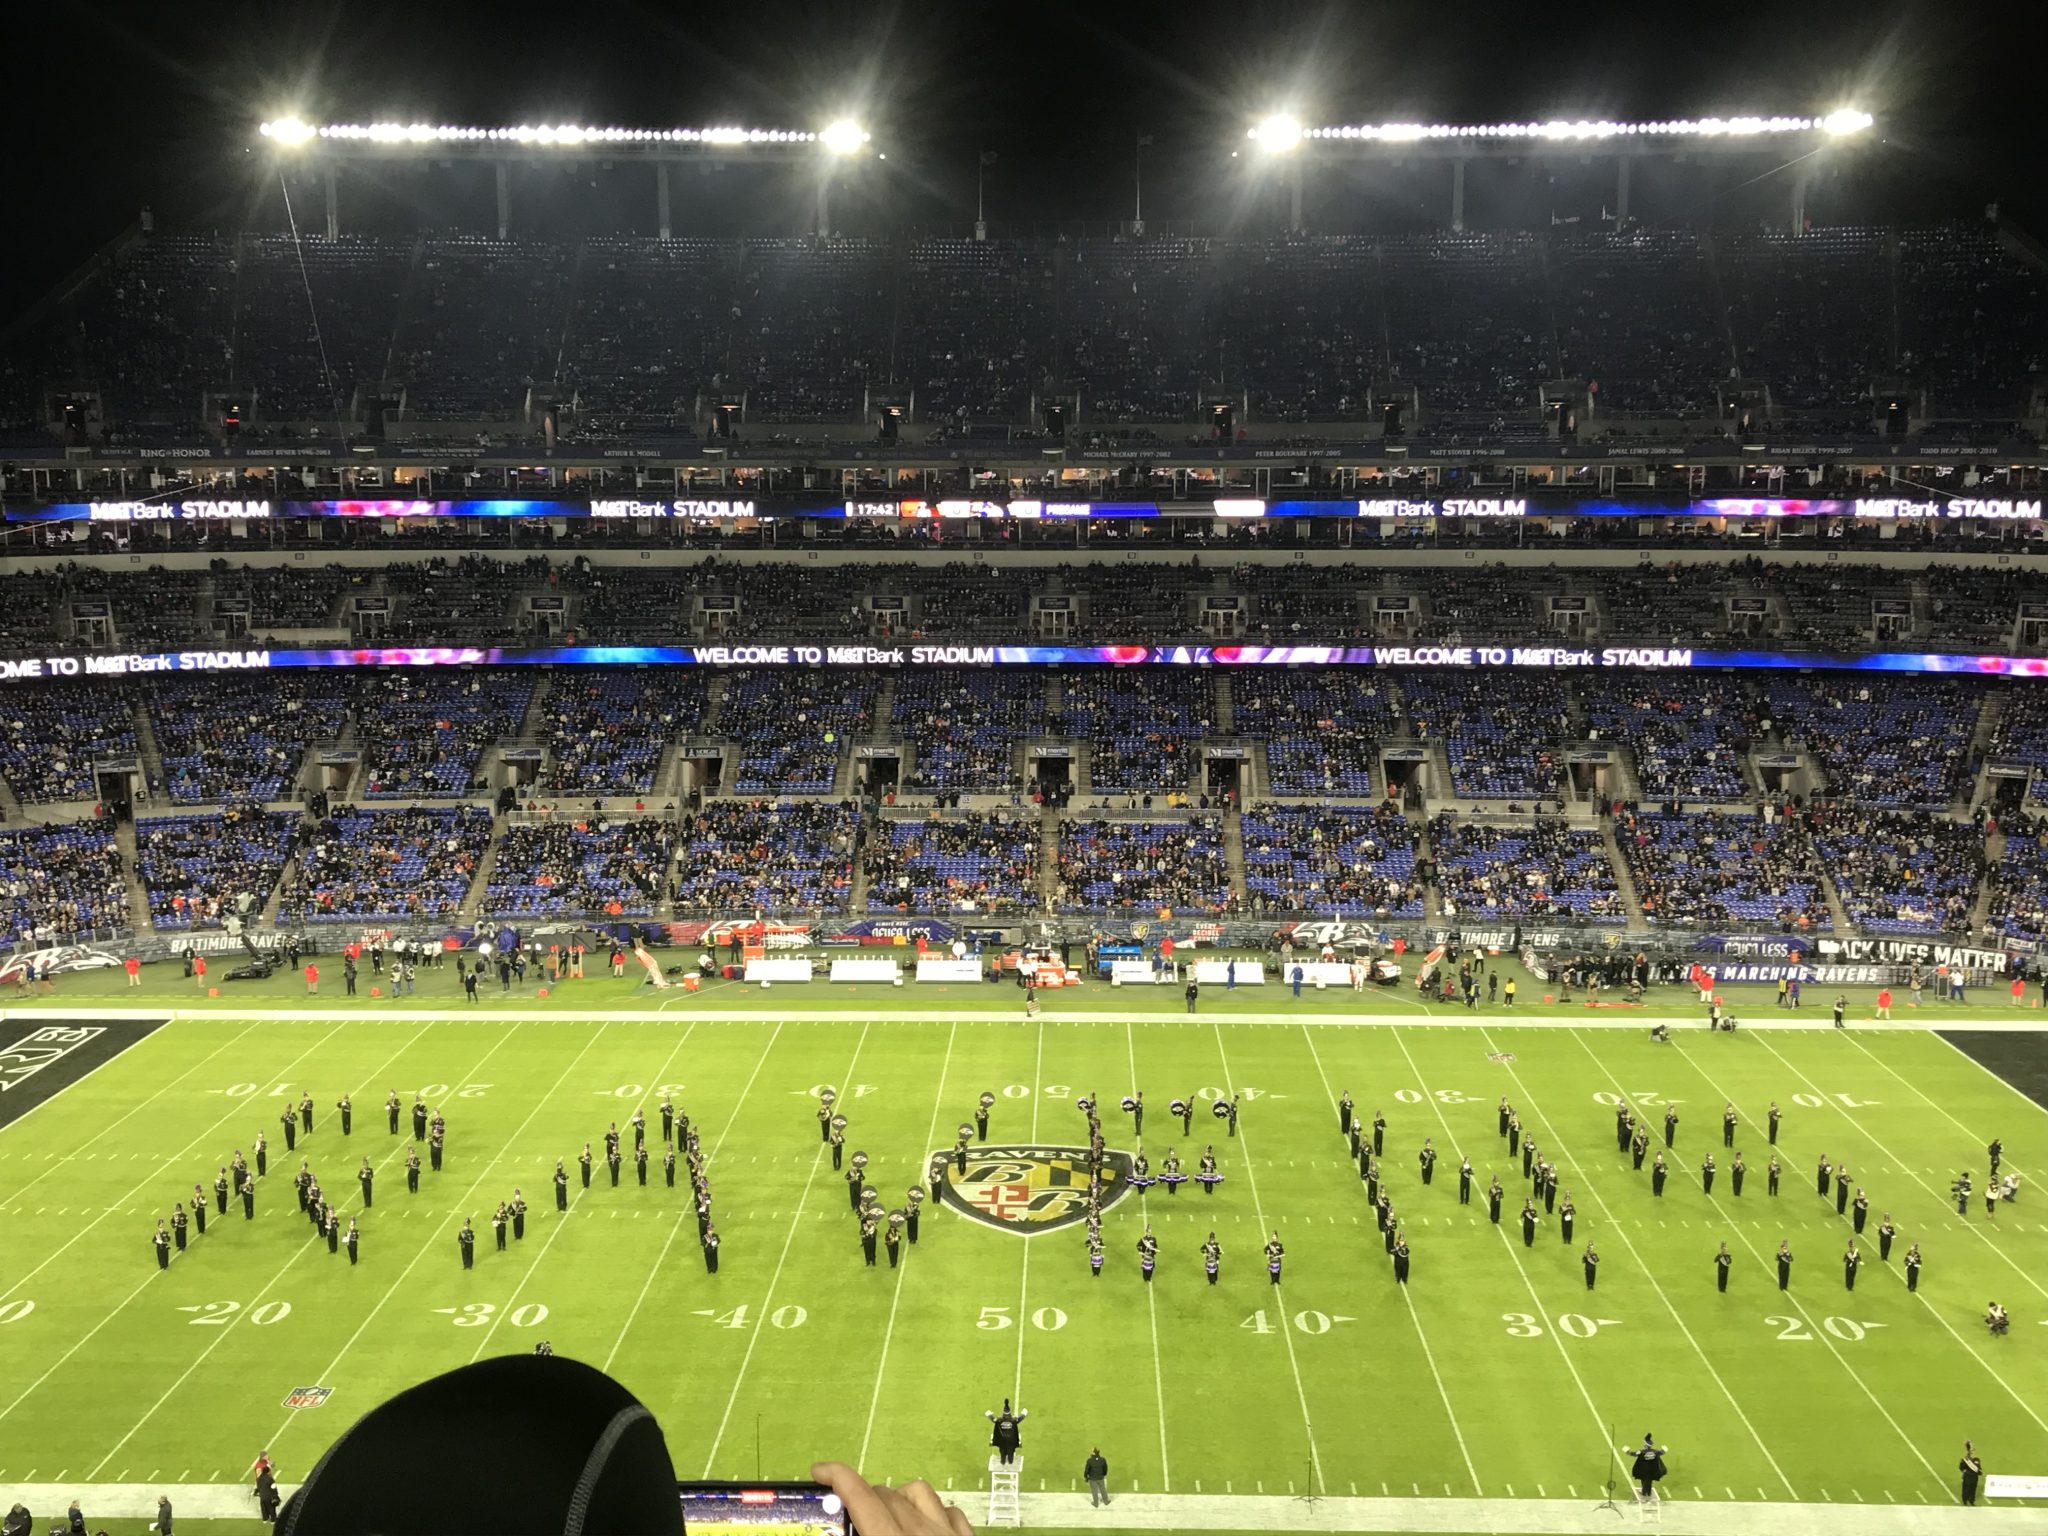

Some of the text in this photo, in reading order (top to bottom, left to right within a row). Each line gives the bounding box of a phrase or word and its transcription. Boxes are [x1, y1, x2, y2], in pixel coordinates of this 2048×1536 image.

[140, 449, 166, 458] RING
[172, 449, 211, 458] HONOR
[181, 501, 269, 518] STADIUM
[673, 501, 754, 517] STADIUM
[857, 503, 894, 516] 17:42
[1442, 500, 1525, 516] STADIUM
[1947, 500, 2042, 518] STADIUM
[46, 658, 79, 675] TO
[180, 651, 269, 669] STADIUM
[693, 648, 788, 663] WELCOME
[793, 648, 822, 663] TO
[911, 648, 994, 663] STADIUM
[1374, 648, 1472, 664] WELCOME
[1476, 648, 1506, 664] TO
[1602, 649, 1692, 666] STADIUM
[170, 937, 243, 952] BALTIMORE
[1879, 942, 1929, 963] LIVES
[1934, 946, 2007, 973] MATTER
[1723, 966, 1809, 980] MARCHING
[1815, 967, 1878, 982] RAVENS
[951, 1150, 1112, 1163] RAVENS
[188, 1300, 292, 1325] 20
[452, 1303, 550, 1327] 30
[714, 1304, 808, 1329] 40
[976, 1306, 1068, 1331] 50
[1239, 1310, 1332, 1334] 40
[1501, 1313, 1598, 1338] 30
[1764, 1315, 1865, 1341] 20
[288, 1396, 320, 1406] NFL
